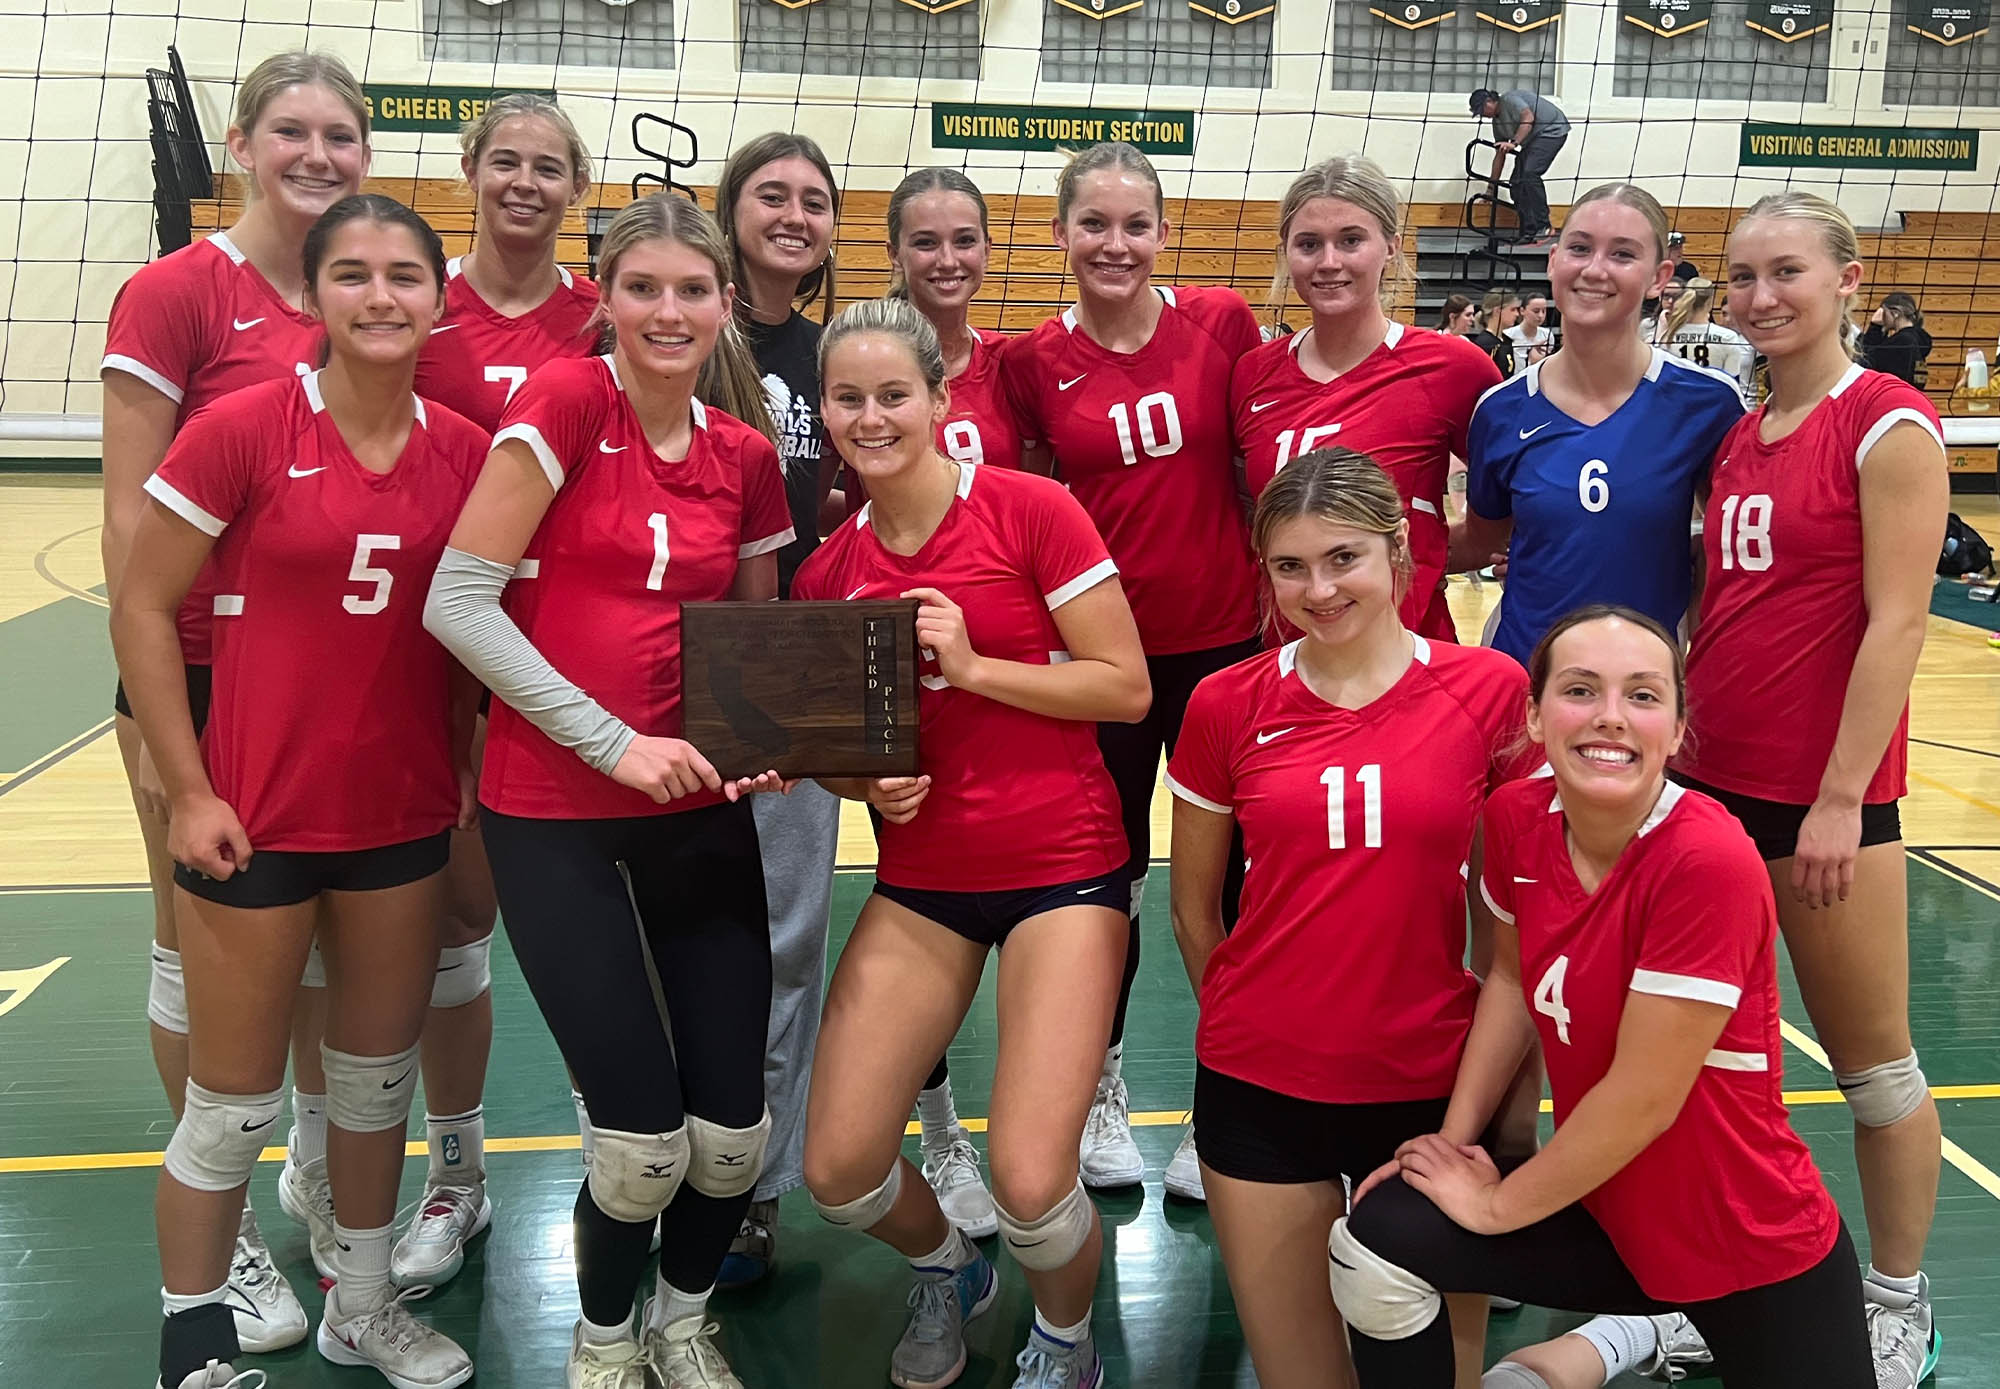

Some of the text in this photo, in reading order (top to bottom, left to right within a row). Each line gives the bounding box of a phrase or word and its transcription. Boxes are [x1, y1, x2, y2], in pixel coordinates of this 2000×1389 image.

[381, 97, 452, 120] CHEER
[943, 115, 1185, 143] VISITING STUDENT SECTION
[1750, 135, 1970, 159] VISITING GENERAL ADMISSION
[484, 365, 528, 425] 7
[769, 411, 811, 436] ALS
[781, 435, 822, 459] BALL
[943, 419, 984, 465] 9
[1107, 391, 1184, 466] 10
[1578, 458, 1610, 513] 6
[646, 512, 670, 591] 1
[1721, 494, 1774, 572] 18
[342, 533, 401, 615] 5
[867, 621, 878, 690] THIRD
[884, 686, 895, 755] PLACE
[1319, 763, 1383, 850] 11
[1533, 954, 1572, 1046] 4
